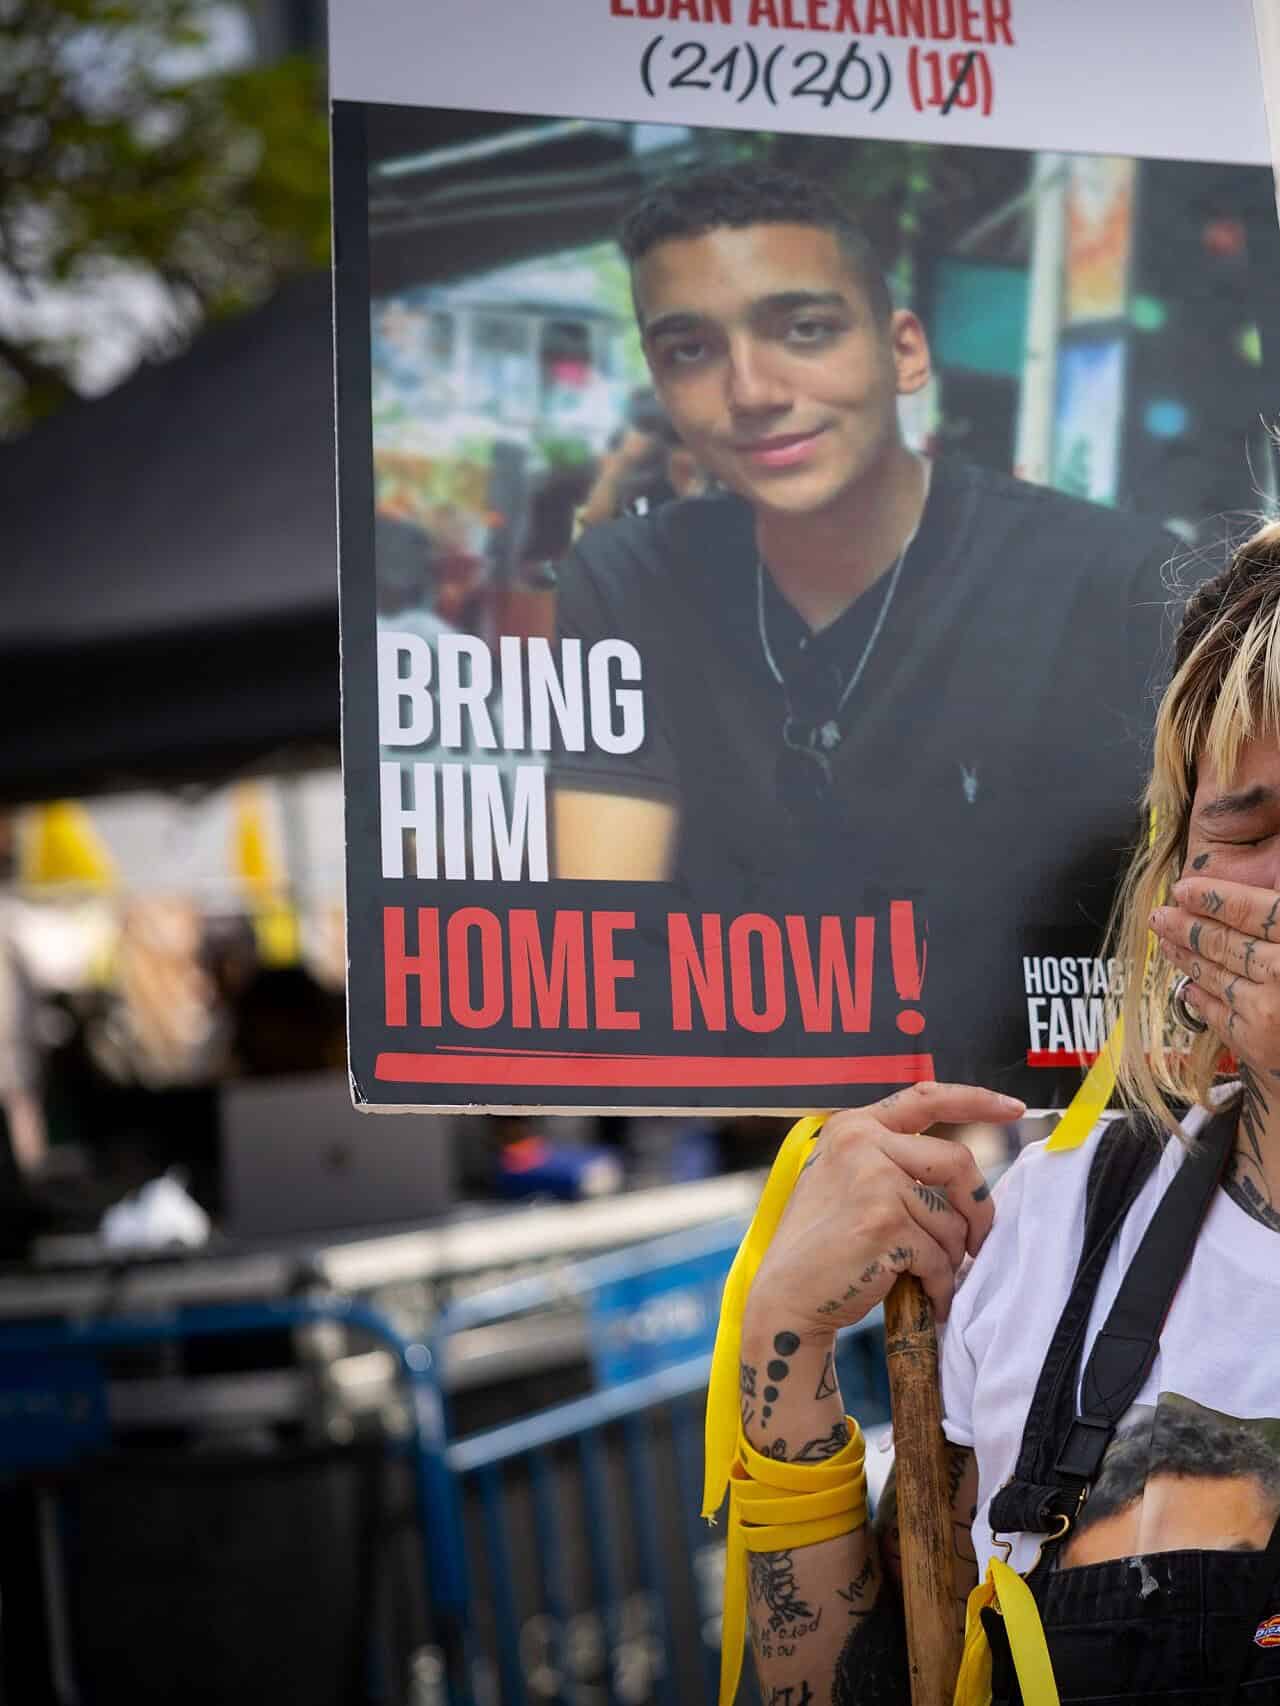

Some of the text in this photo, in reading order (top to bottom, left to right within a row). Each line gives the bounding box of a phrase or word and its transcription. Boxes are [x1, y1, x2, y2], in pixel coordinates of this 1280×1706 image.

[748, 0, 1014, 45] ALEXANDER
[377, 631, 646, 754] BRING
[380, 761, 549, 882] HIM
[383, 900, 928, 1035] HOME NOW!
[1023, 956, 1157, 994] HOSTAG
